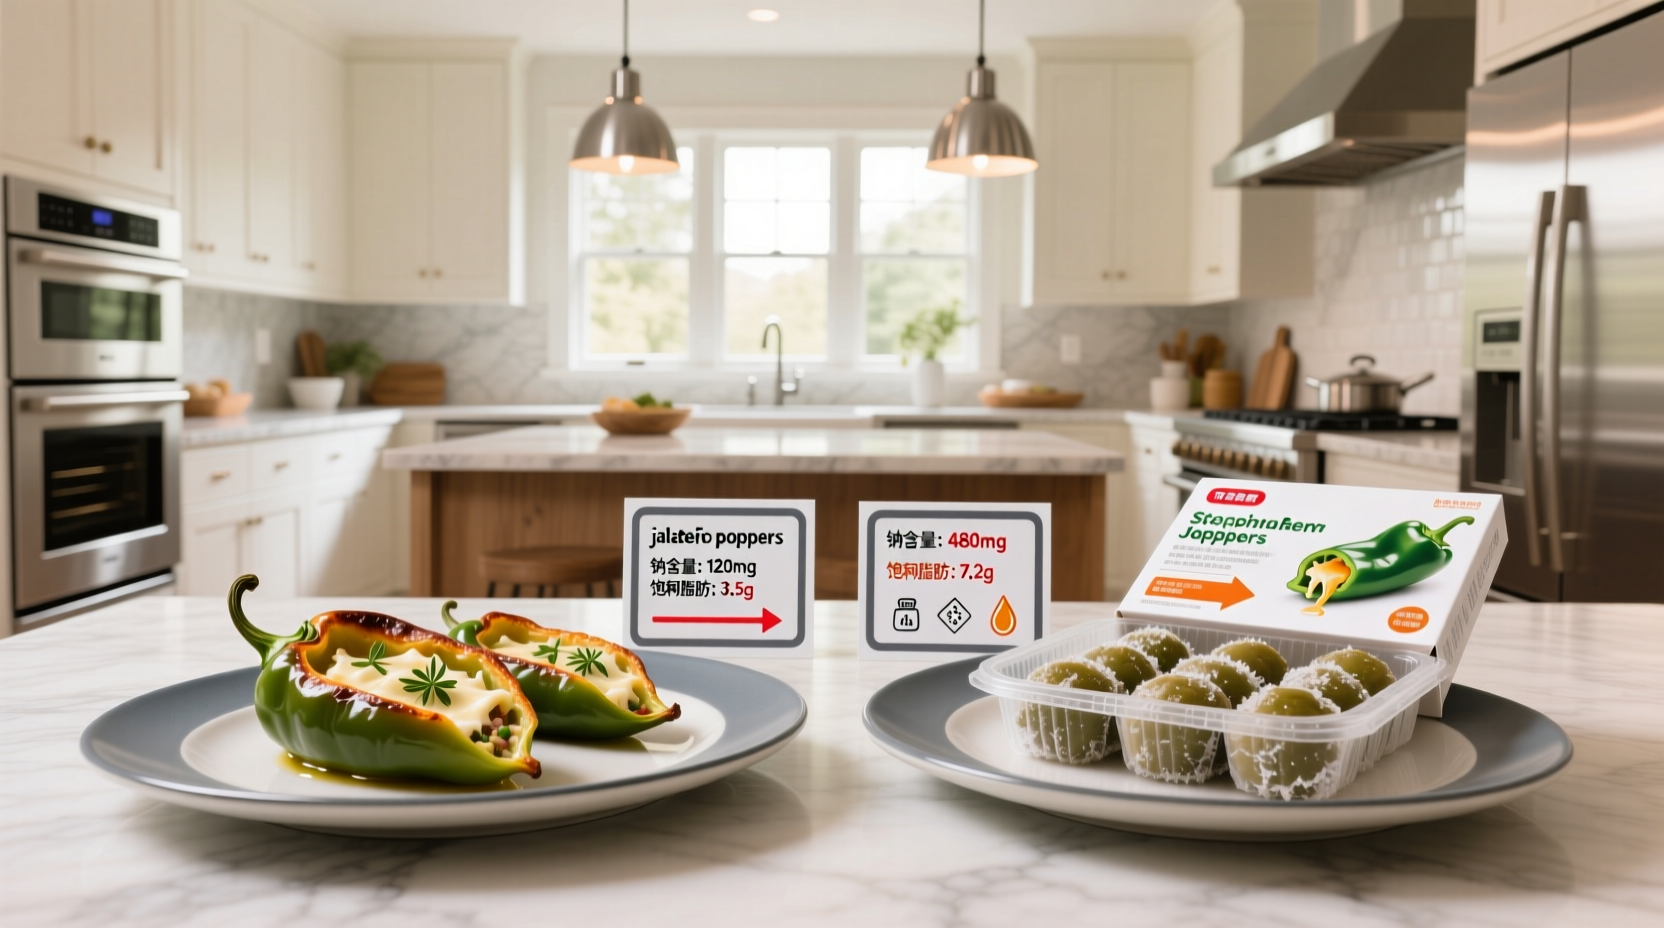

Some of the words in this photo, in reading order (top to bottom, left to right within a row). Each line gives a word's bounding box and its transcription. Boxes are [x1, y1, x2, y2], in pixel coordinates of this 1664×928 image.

[715, 532, 784, 549] poppers
[948, 531, 1007, 553] 480mg
[707, 558, 756, 578] 120mg
[959, 563, 994, 584] 7.2g
[720, 581, 754, 601] 3.5g
